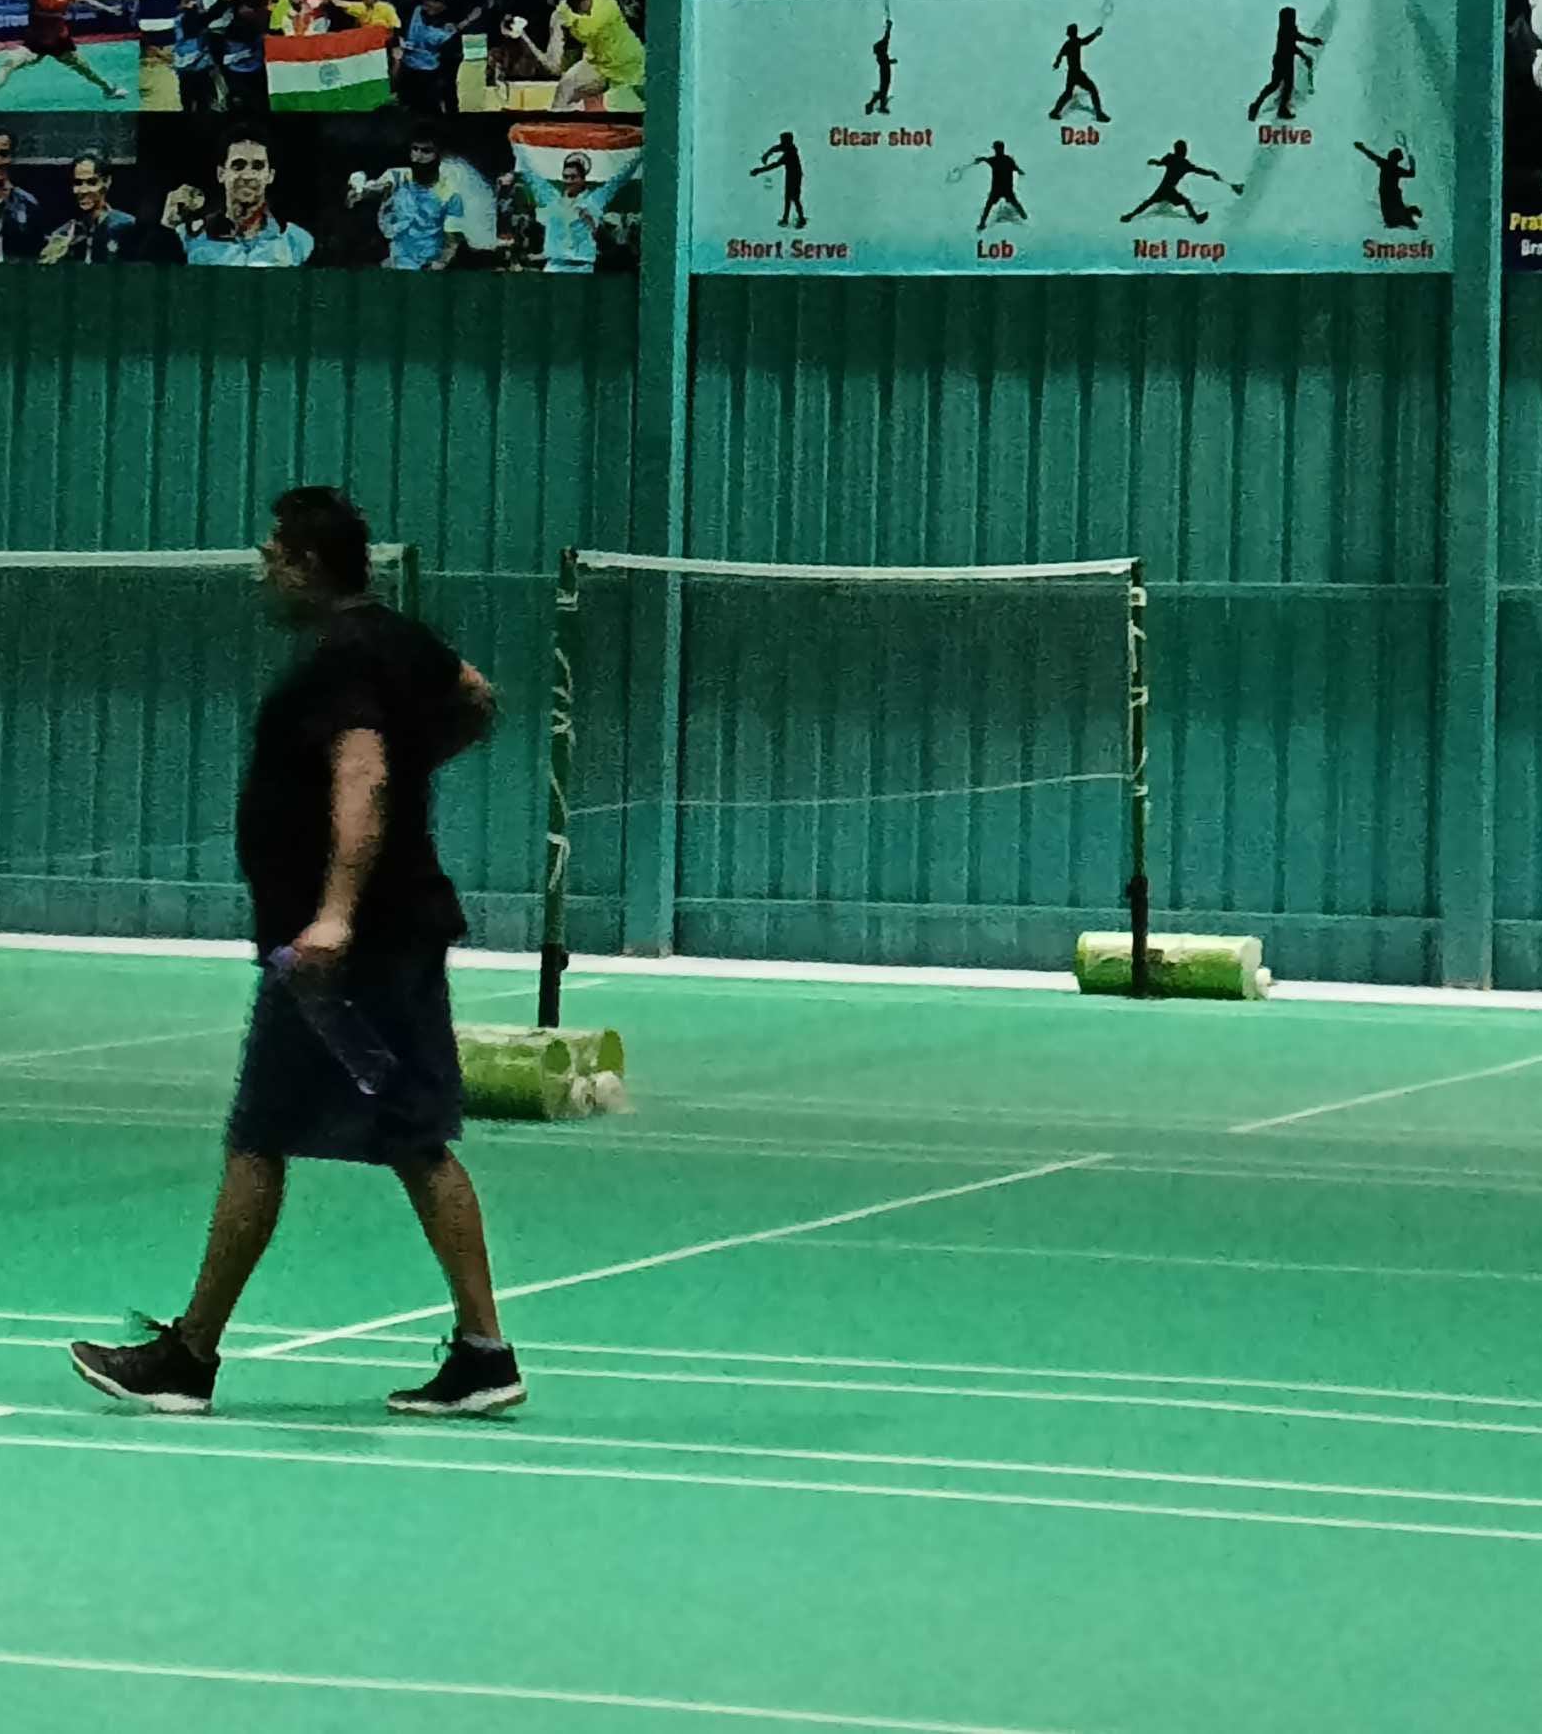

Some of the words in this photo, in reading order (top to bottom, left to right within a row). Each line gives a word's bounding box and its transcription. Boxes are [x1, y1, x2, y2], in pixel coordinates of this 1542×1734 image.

[829, 126, 881, 146] Clear
[888, 127, 933, 147] shot
[1061, 126, 1100, 146] Dab
[1259, 125, 1312, 145] Drive
[727, 239, 783, 259] Short
[790, 239, 848, 259] Serve
[977, 239, 1014, 259] Lob
[1133, 239, 1168, 259] Net
[1176, 239, 1226, 262] Drop
[1362, 238, 1434, 259] Smash
